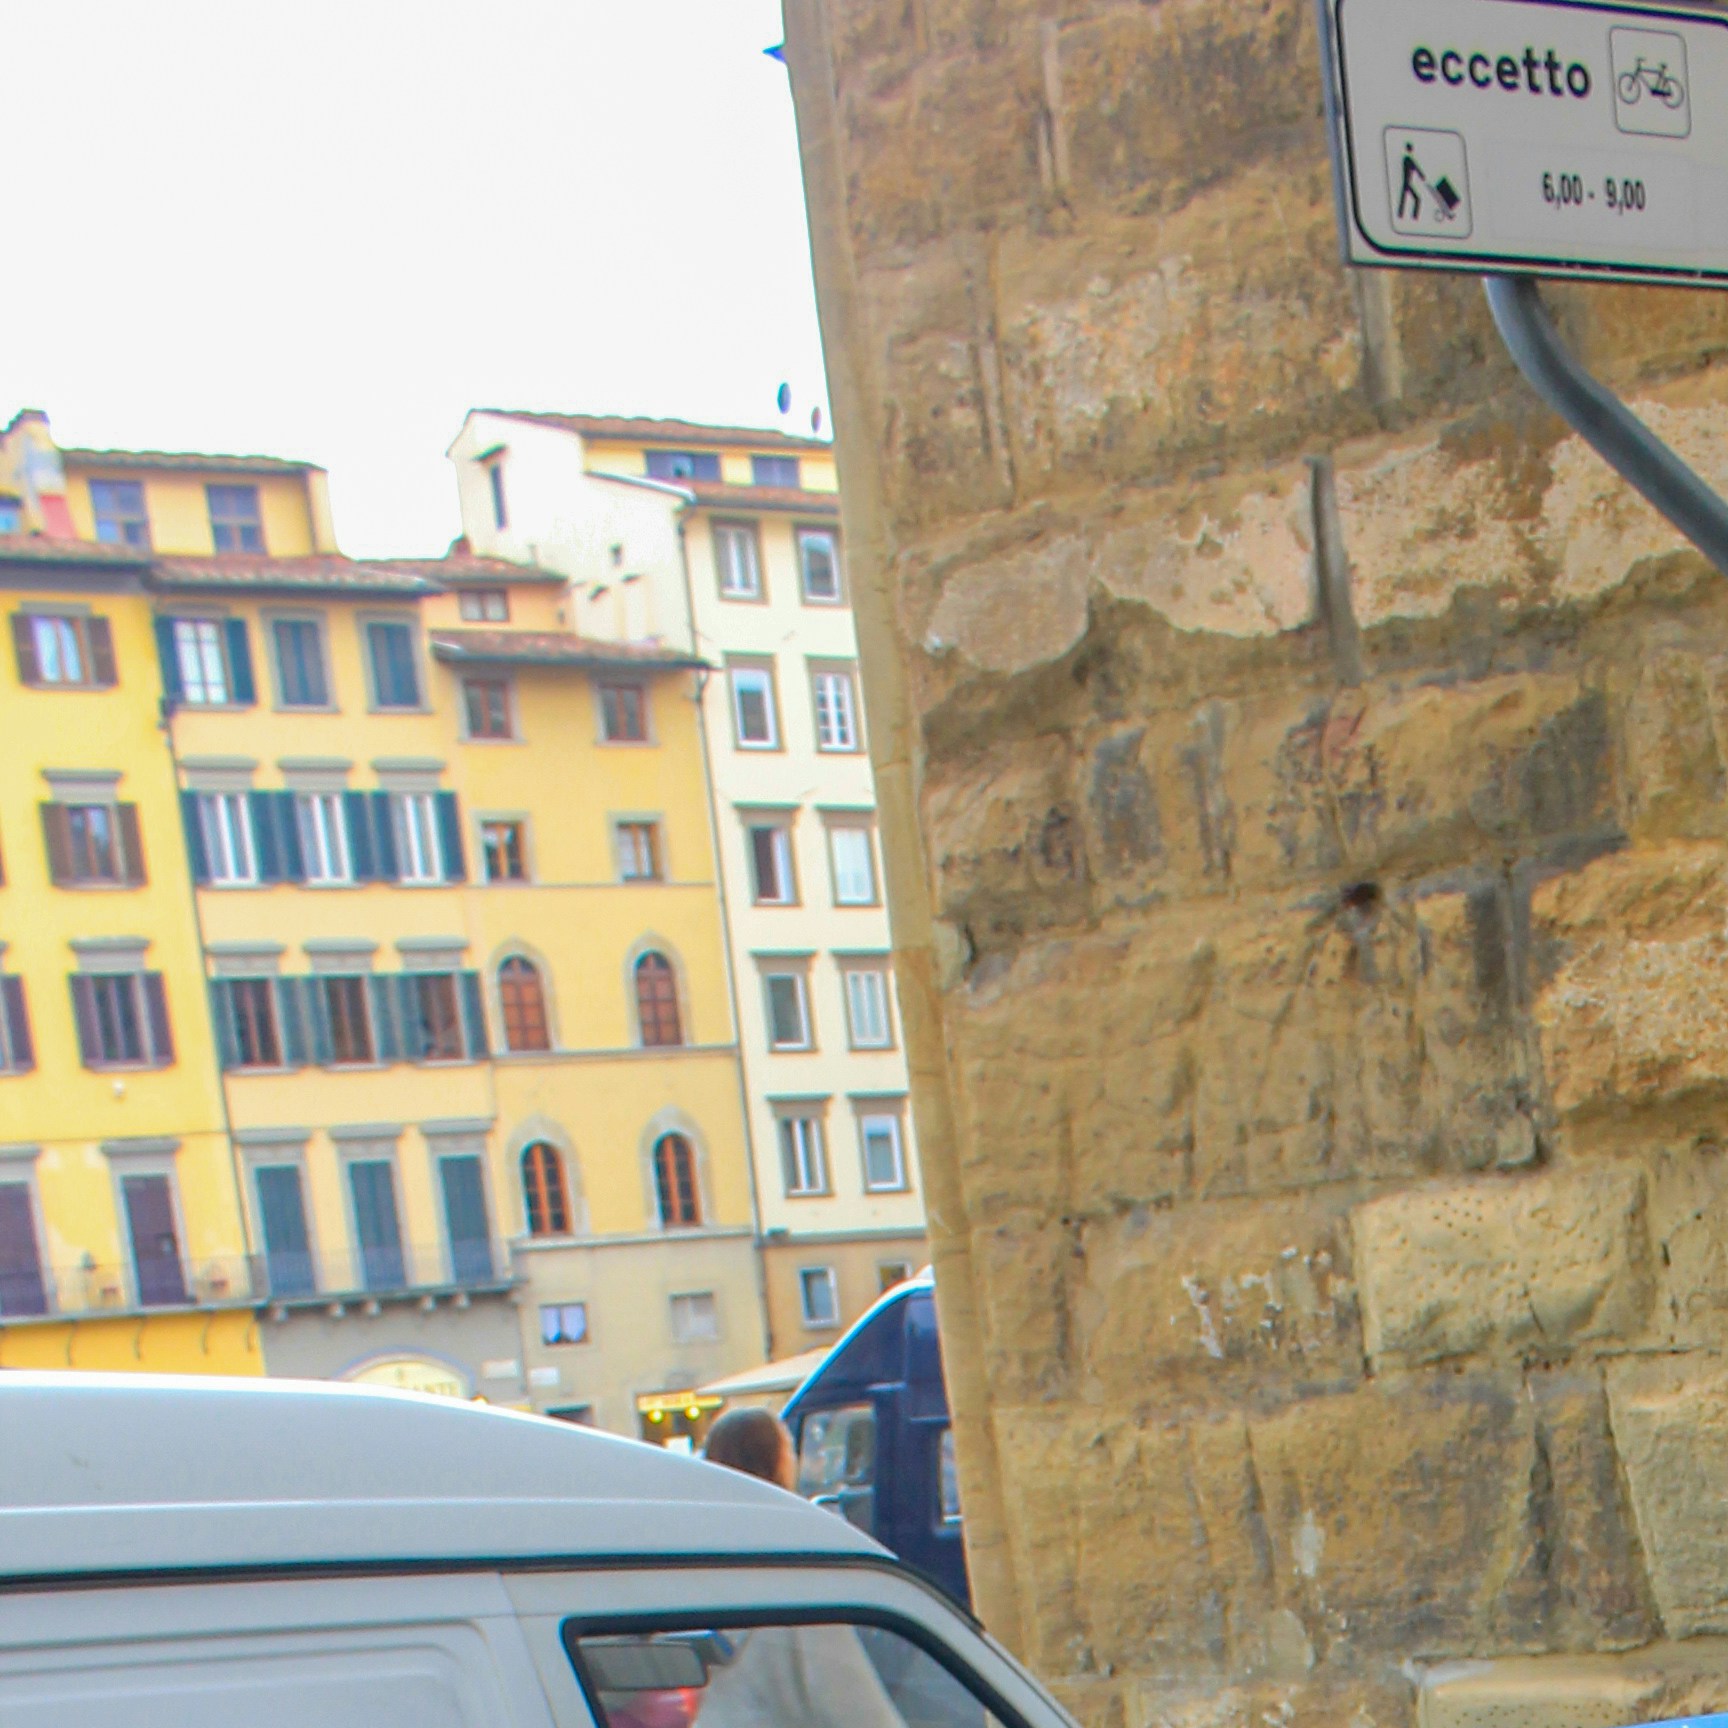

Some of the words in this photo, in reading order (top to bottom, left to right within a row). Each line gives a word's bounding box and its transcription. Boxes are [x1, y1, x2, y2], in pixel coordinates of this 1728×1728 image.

[1412, 46, 1591, 98] eccetto
[1542, 172, 1582, 212] 6,00
[1605, 178, 1646, 215] 9,00
